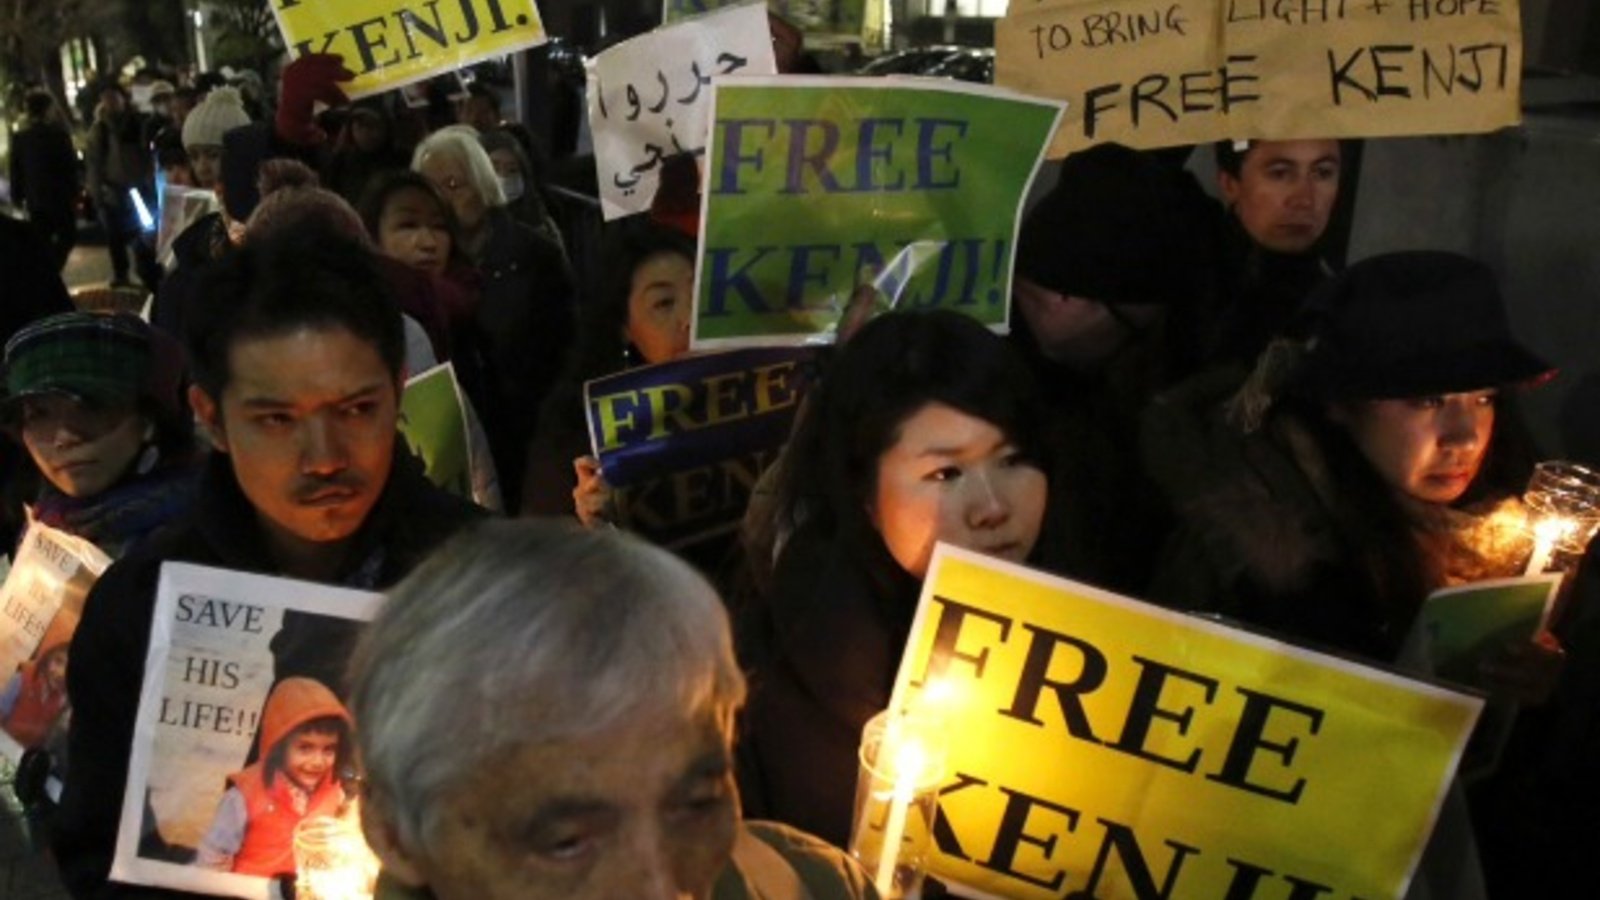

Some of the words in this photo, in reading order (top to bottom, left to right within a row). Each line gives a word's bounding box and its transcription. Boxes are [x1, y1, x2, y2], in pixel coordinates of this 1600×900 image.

[1030, 24, 1072, 59] TO
[1081, 4, 1187, 47] BRING
[1083, 55, 1261, 138] FREE
[1326, 43, 1508, 106] KENJI
[710, 117, 969, 196] FREE
[590, 360, 798, 454] FREE
[174, 594, 266, 634] SAVE
[182, 655, 241, 689] HIS
[909, 594, 1326, 805] FREE
[158, 697, 258, 737] LIFE!!
